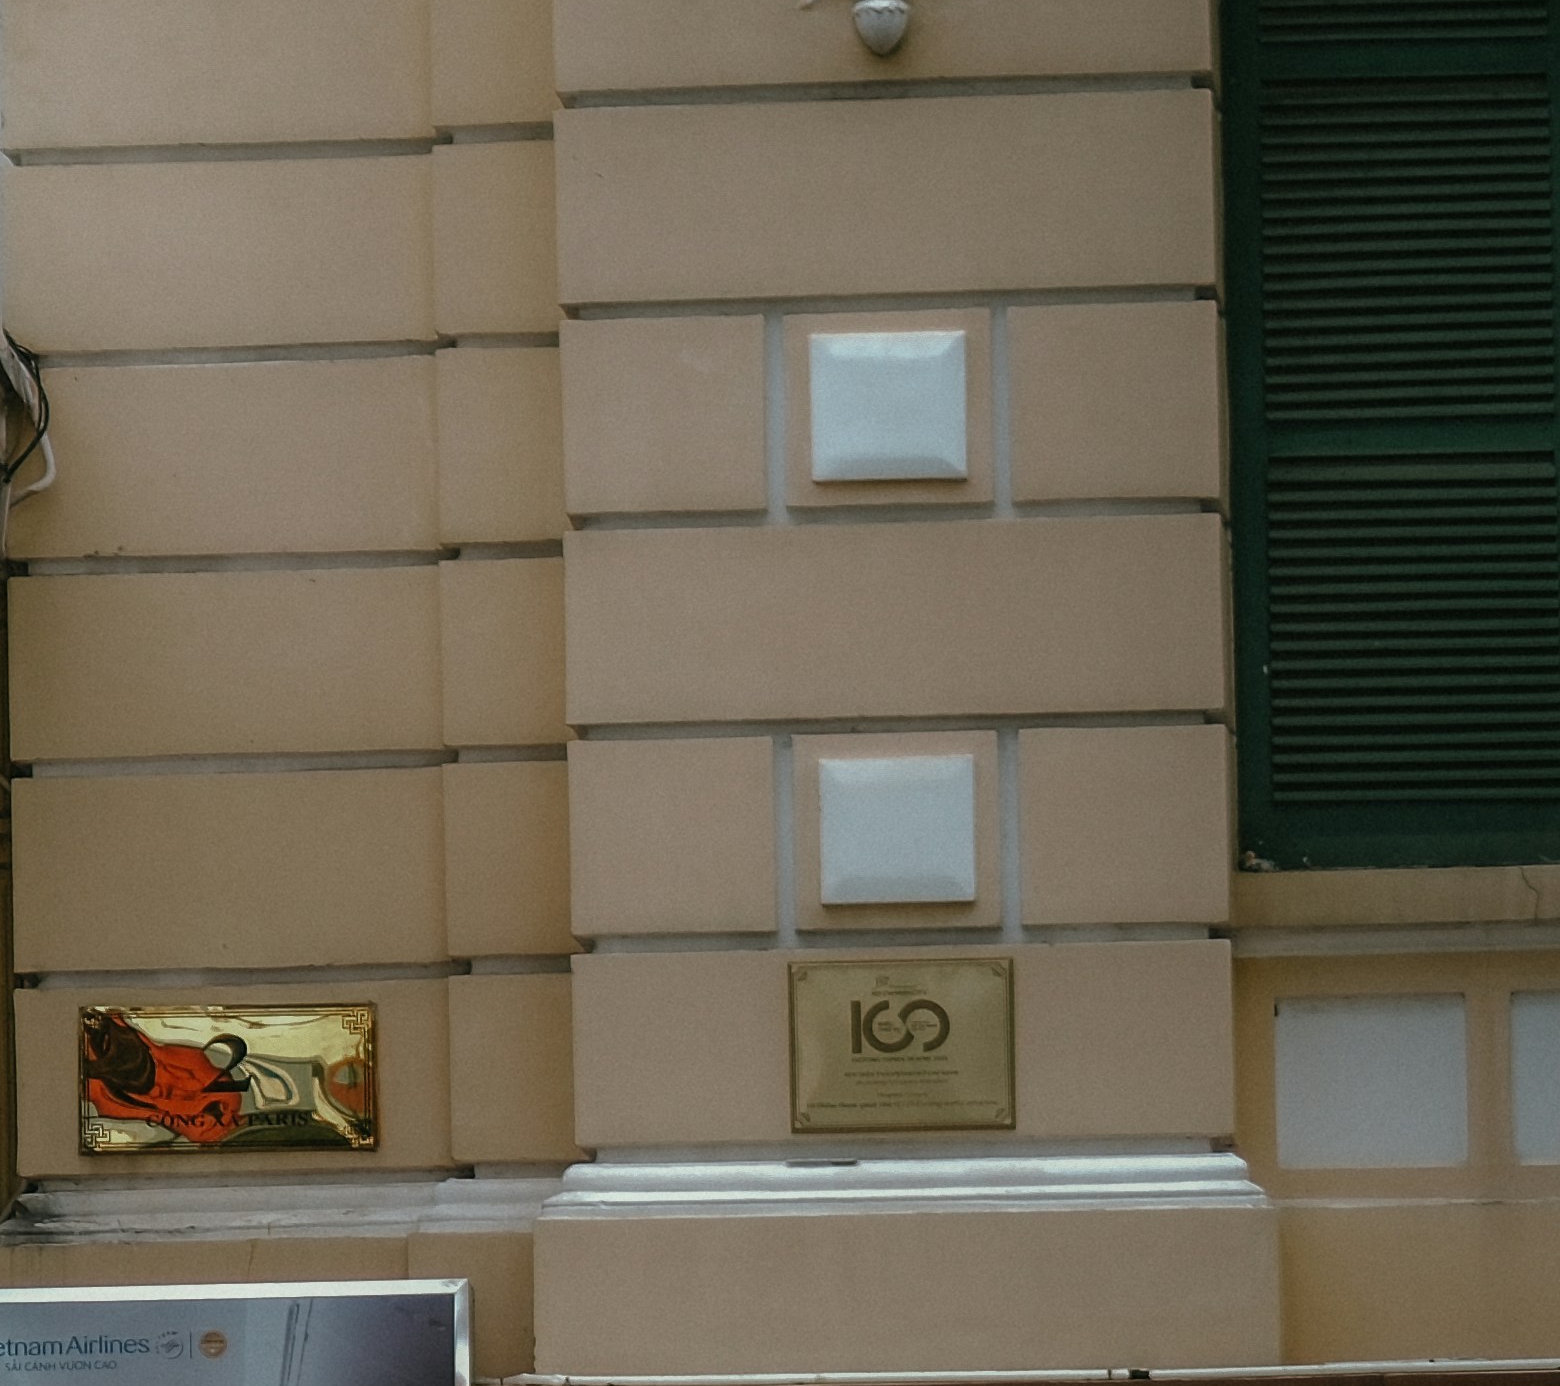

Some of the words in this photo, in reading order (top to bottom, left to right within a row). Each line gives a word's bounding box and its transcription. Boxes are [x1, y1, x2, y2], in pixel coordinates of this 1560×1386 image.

[203, 1033, 251, 1093] 2
[146, 1110, 205, 1128] CÔNG
[246, 1111, 309, 1127] PARIS
[65, 1334, 150, 1355] Airlines
[94, 1359, 118, 1371] CAO
